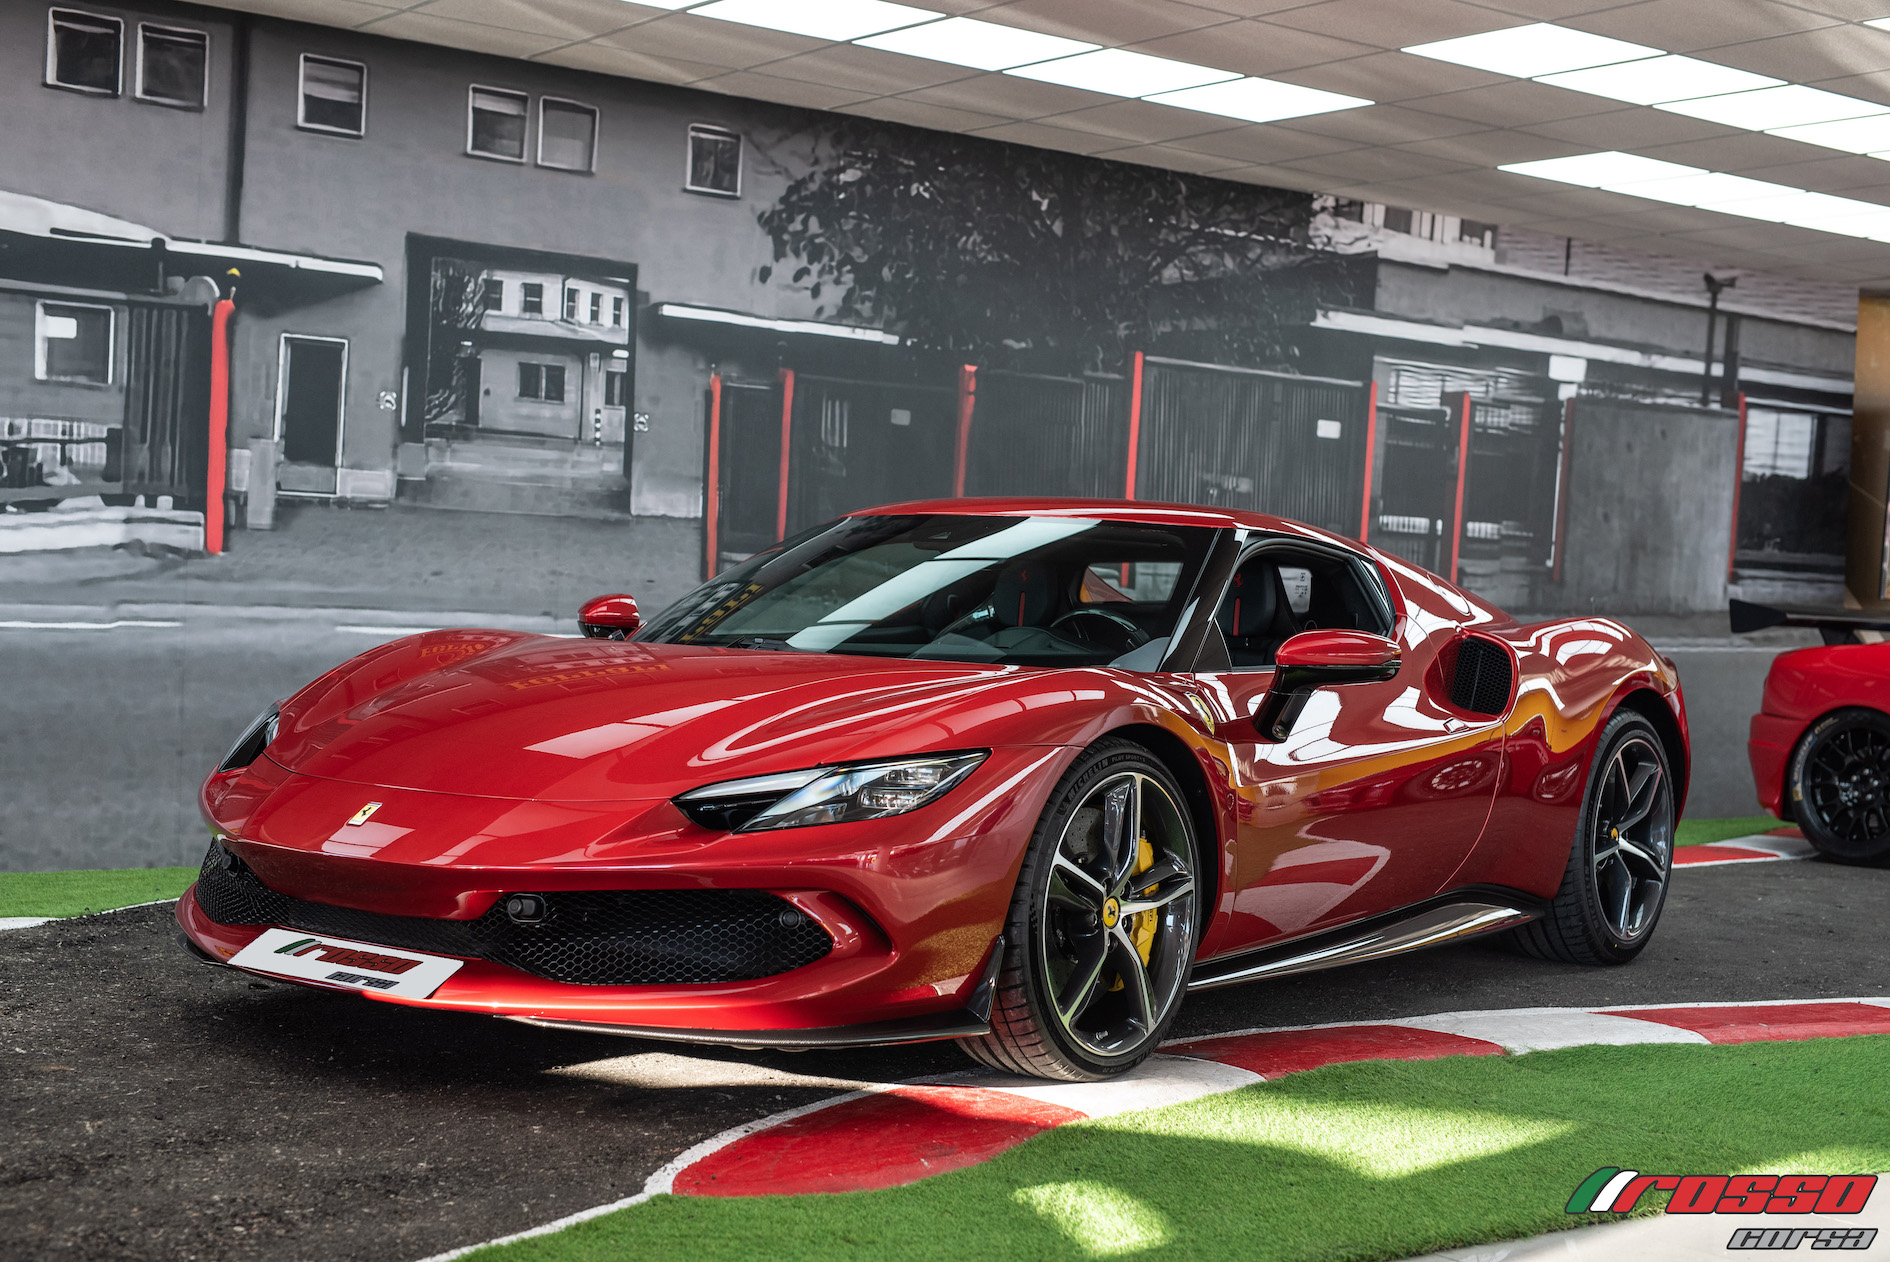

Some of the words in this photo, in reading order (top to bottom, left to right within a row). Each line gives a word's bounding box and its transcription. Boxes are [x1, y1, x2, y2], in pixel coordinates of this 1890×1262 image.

[1068, 759, 1109, 800] MICHELIN
[292, 944, 424, 975] rosso
[325, 971, 400, 990] corsa
